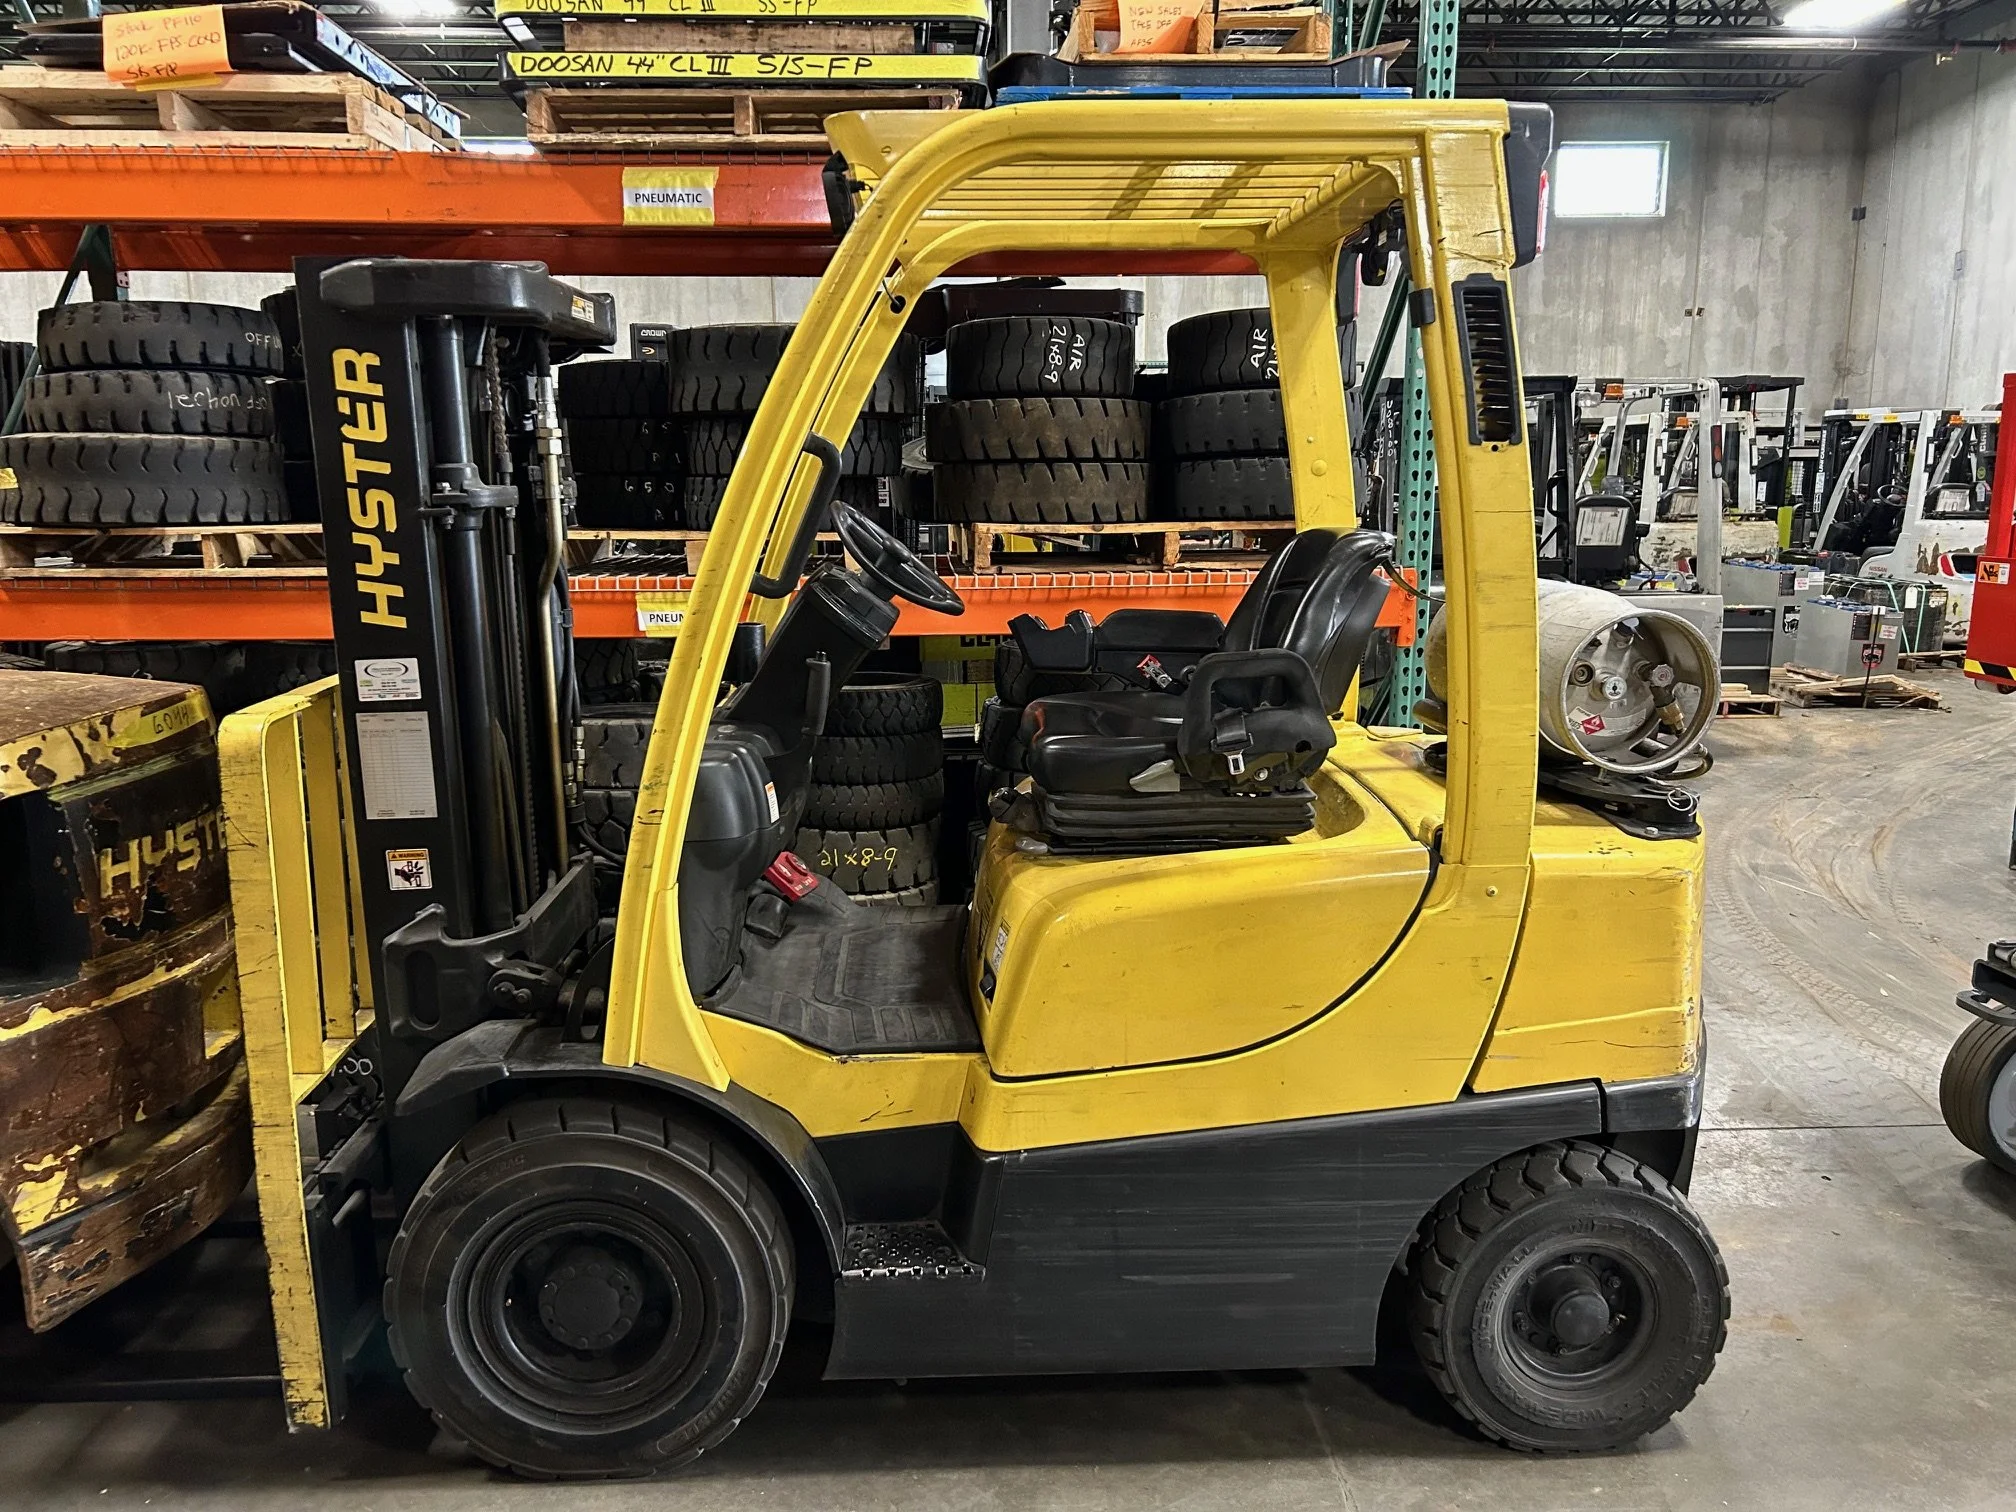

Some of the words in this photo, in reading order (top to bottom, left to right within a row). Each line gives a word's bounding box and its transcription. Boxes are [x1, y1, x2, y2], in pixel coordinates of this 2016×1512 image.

[520, 55, 614, 74] DOOSAN
[670, 55, 703, 73] CL
[634, 192, 703, 204] PNEUMATIC
[1069, 333, 1086, 371] AIR
[1250, 328, 1268, 369] AIR
[332, 348, 408, 629] HYSTER
